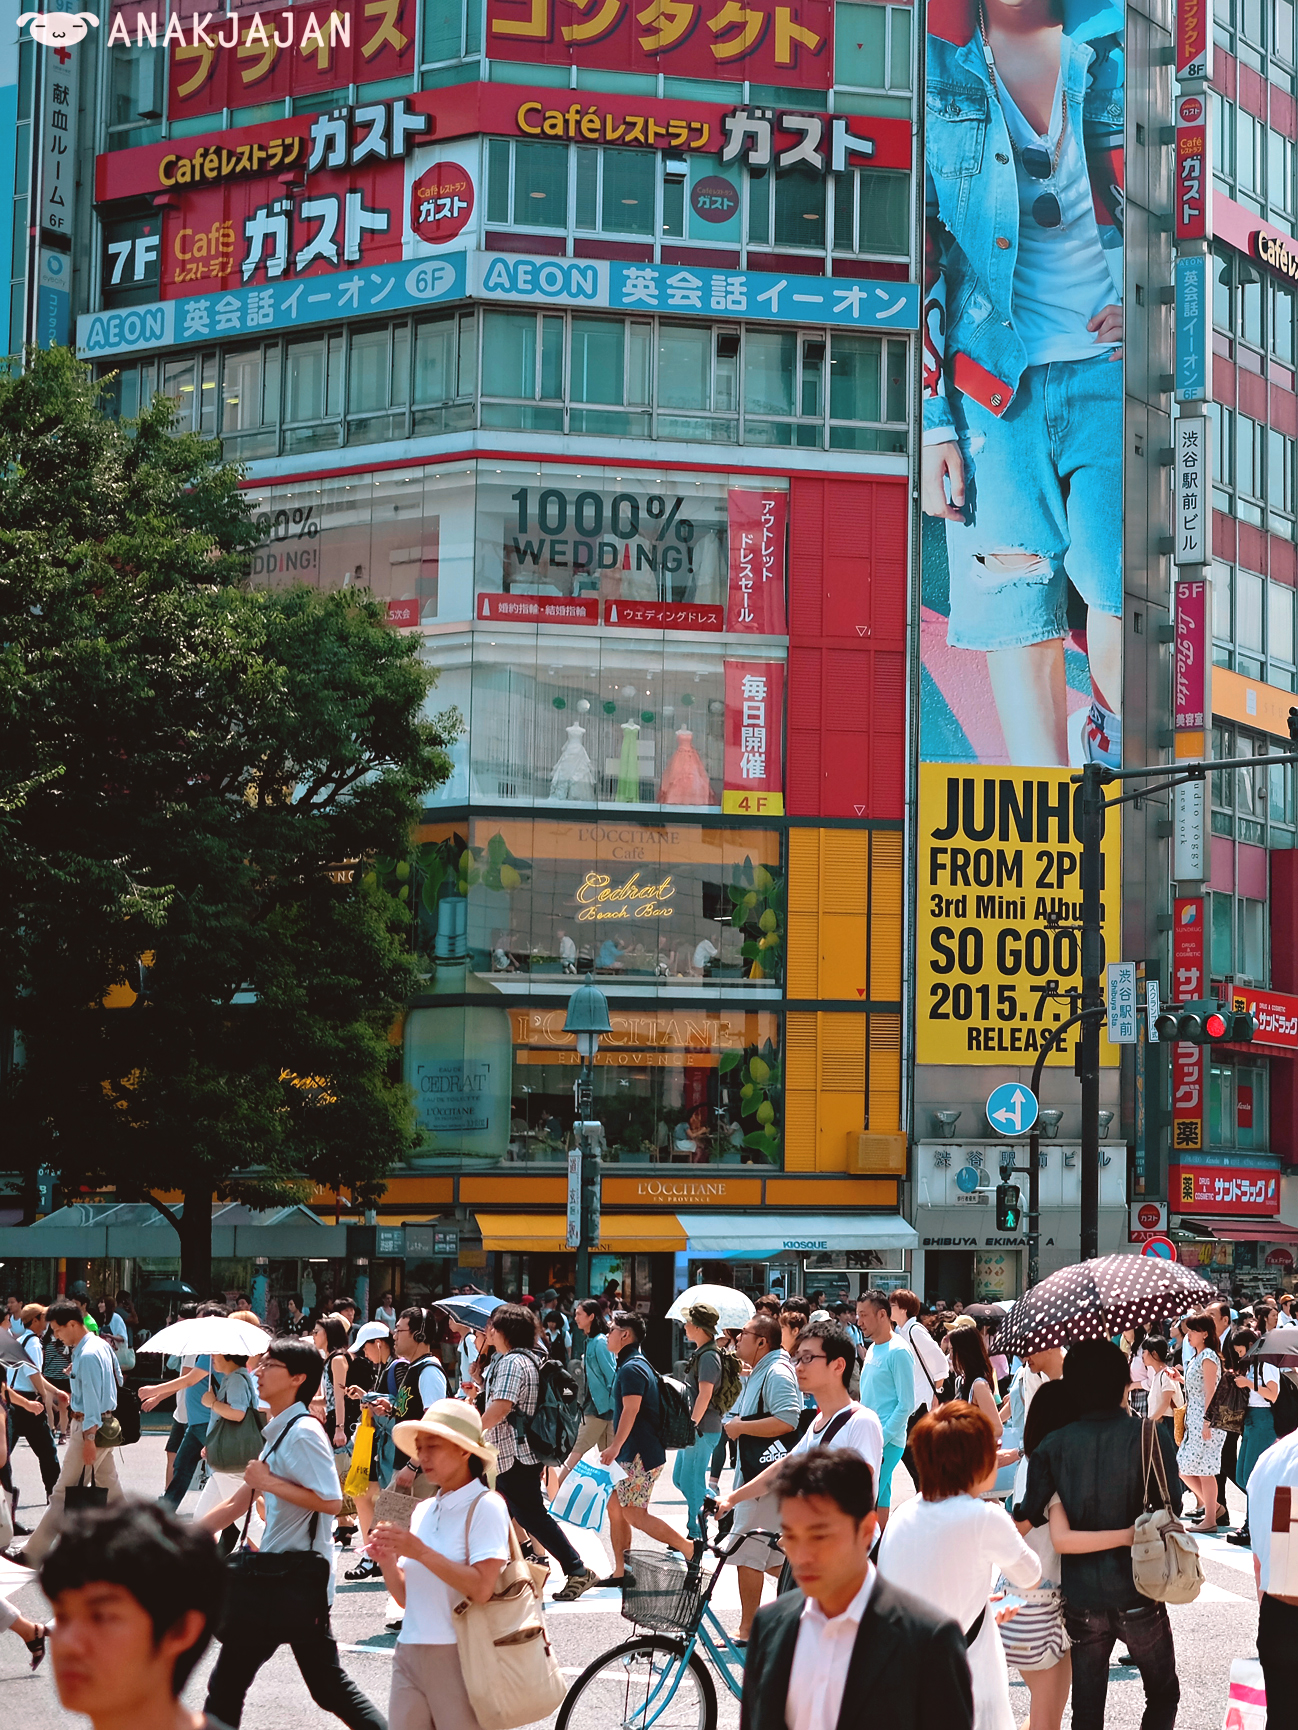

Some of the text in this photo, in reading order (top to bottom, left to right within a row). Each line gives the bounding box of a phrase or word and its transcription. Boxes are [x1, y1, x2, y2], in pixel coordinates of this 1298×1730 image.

[1188, 63, 1205, 77] 8F
[50, 82, 70, 207] 献血ルーム
[307, 100, 428, 173] ガスト
[517, 101, 876, 173] Caféレストラン ガスト
[696, 194, 735, 212] ガスト
[1180, 155, 1202, 226] ガスト
[49, 212, 65, 228] 6F
[418, 196, 468, 224] ガスト
[174, 219, 236, 261] Café
[242, 191, 389, 283] ガスト
[107, 233, 160, 286] 7F
[1178, 256, 1205, 267] AEON
[484, 257, 600, 300] AEON
[621, 266, 908, 321] 英会話イーオン
[182, 264, 448, 338] 英会話イーオン 6F
[86, 307, 165, 350] AEON
[1183, 269, 1200, 400] 英会話イーオン 6F
[1181, 430, 1199, 551] 渋谷駅前ビル
[511, 487, 696, 543] 1000%
[511, 535, 696, 575] WEDDING!
[760, 499, 776, 583] アウトレット
[737, 532, 754, 624] ドレスセール
[1177, 583, 1204, 599] 5F
[622, 607, 718, 626] ウェディングドレス
[740, 673, 768, 780] 毎日開催
[1175, 712, 1204, 728] 美容室
[578, 826, 680, 845] L'OCCITANE
[1190, 824, 1201, 870] yoggy
[612, 845, 645, 861] Café
[929, 847, 1024, 888] FROM
[929, 893, 968, 919] 3rd
[975, 894, 1026, 921] Mini
[929, 926, 984, 976] SO
[1110, 979, 1119, 1011] Shibuya
[1118, 968, 1133, 1037] 渋谷駅前
[516, 1009, 732, 1048] L'OCITANE
[1258, 1011, 1298, 1036] サンドラッグ
[966, 1026, 1069, 1053] RELEASE
[421, 1074, 487, 1093] CEDRAT
[1175, 1119, 1200, 1147] 薬
[637, 1180, 727, 1196] L'OCCITANE
[1182, 1176, 1193, 1201] 薬
[1198, 1177, 1210, 1186] DRUG
[1214, 1177, 1266, 1203] サンドラッグ
[1140, 1214, 1159, 1223] ガスト
[782, 1239, 828, 1250] KIOSQUE
[922, 1237, 978, 1246] SHIBUYA
[1139, 1231, 1155, 1240] 入口
[759, 1451, 788, 1464] adida
